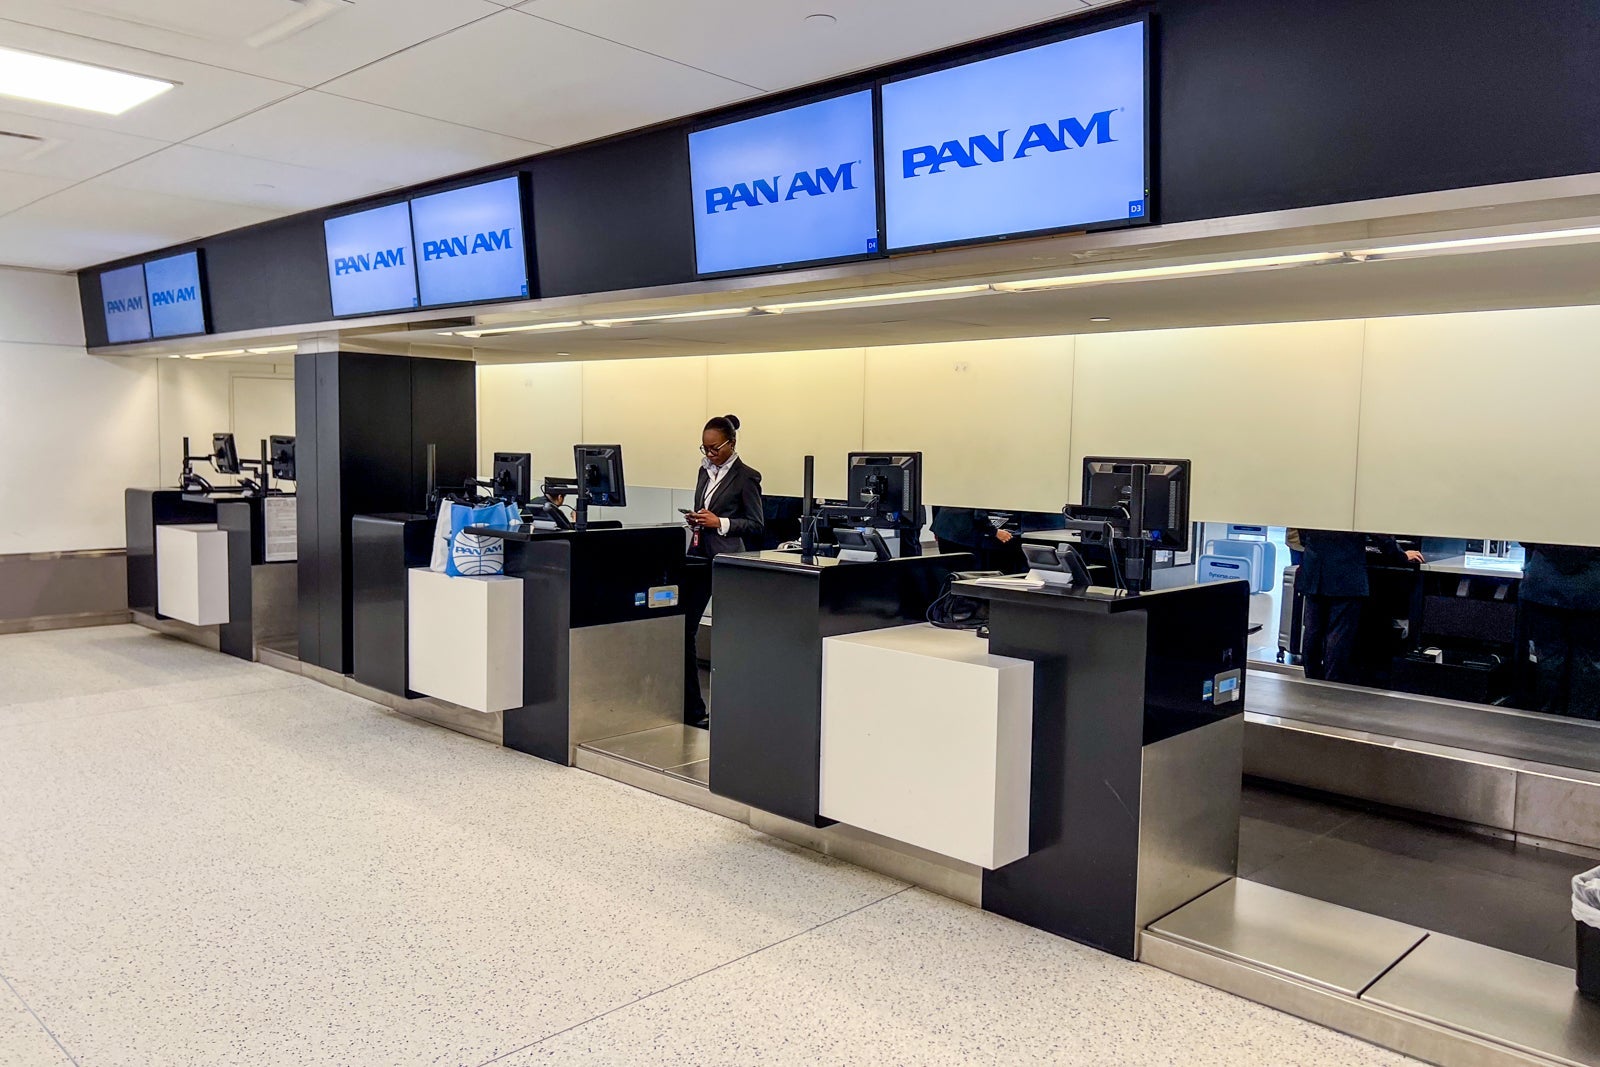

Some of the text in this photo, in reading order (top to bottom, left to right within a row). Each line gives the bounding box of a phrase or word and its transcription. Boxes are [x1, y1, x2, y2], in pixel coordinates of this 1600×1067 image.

[902, 108, 1119, 179] PAN AM
[705, 161, 858, 214] PAN AM
[1131, 204, 1141, 212] D3
[423, 228, 513, 261] PAN AM
[334, 247, 406, 276] PAN AM
[107, 296, 143, 314] PAN AM
[152, 286, 196, 306] PAN AM
[455, 544, 502, 555] PAN AM
